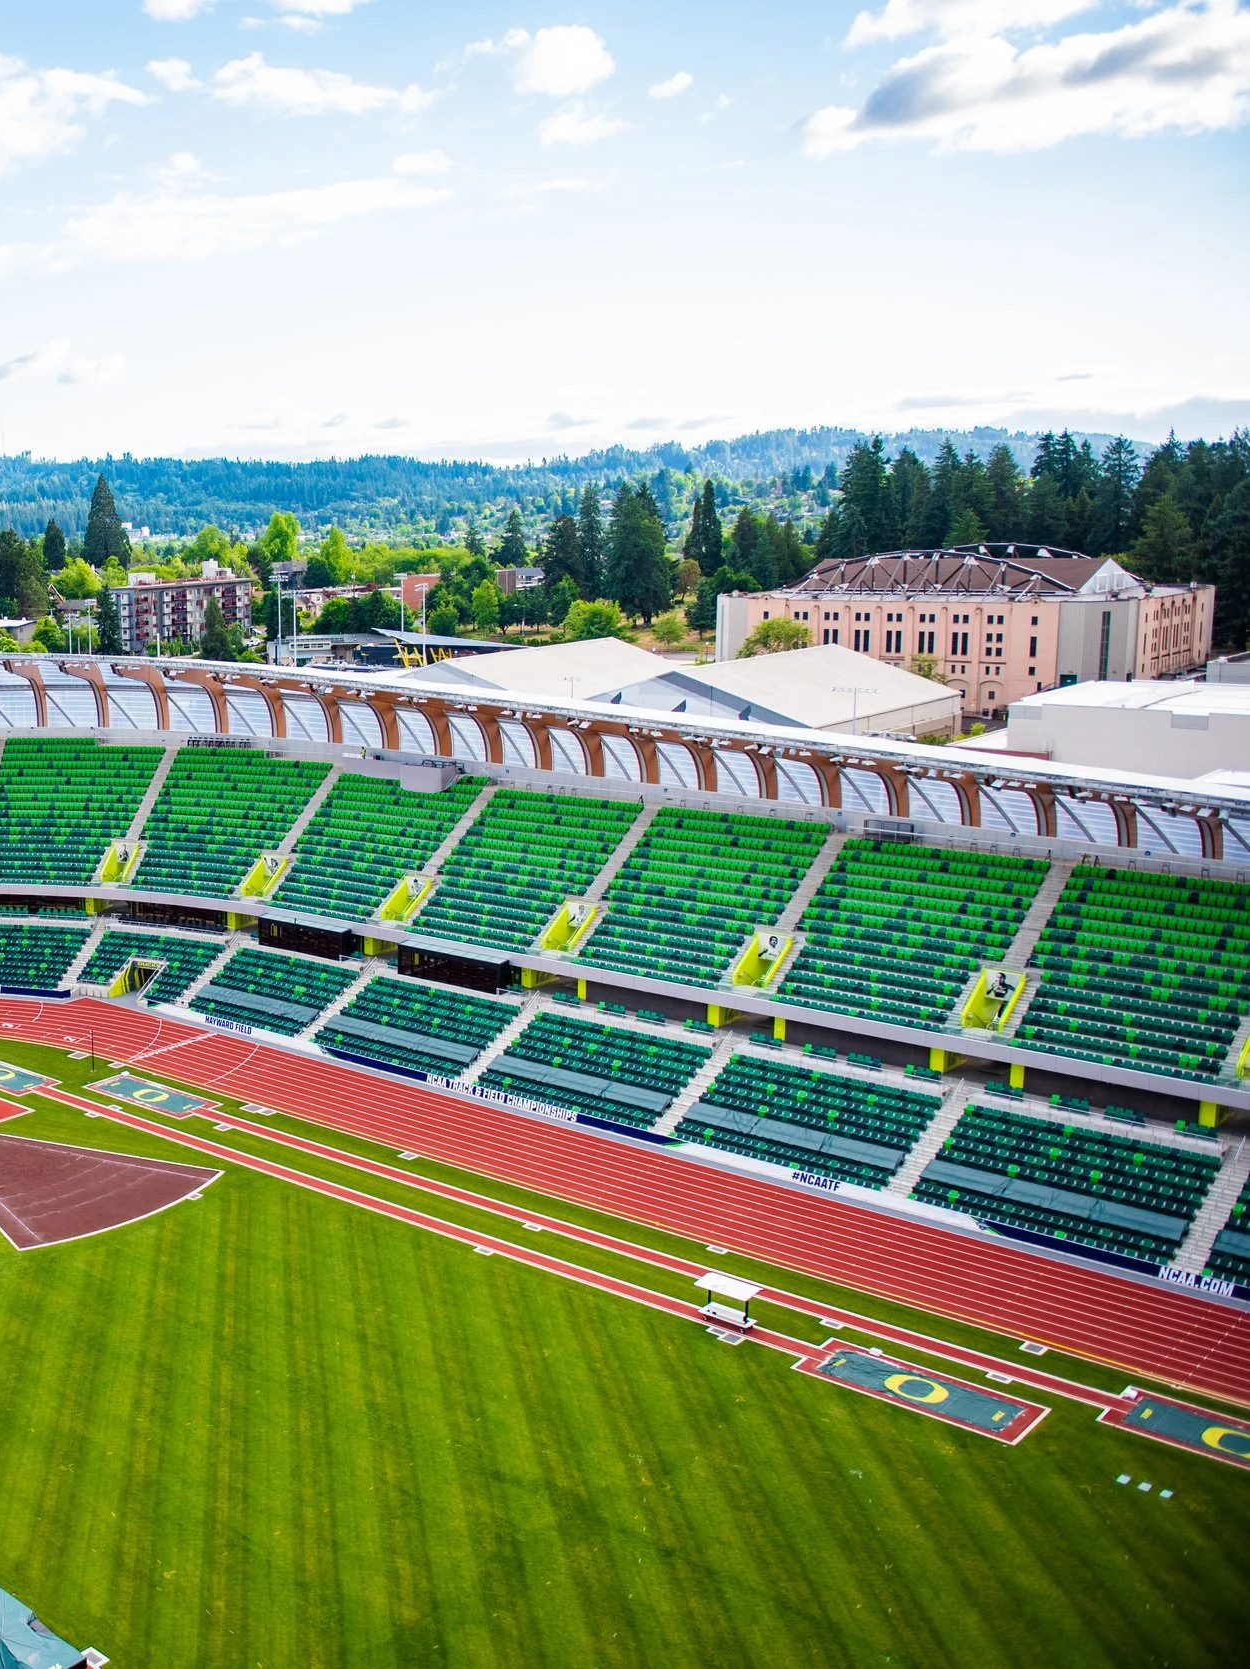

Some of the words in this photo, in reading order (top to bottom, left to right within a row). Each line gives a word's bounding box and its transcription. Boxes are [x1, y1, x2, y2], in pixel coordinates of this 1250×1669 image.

[205, 1015, 234, 1030] HAYWARD
[235, 1023, 252, 1034] FIELD
[427, 1073, 447, 1088] NCAA
[449, 1079, 474, 1096] TRACK
[483, 1088, 505, 1103] FIELD
[506, 1093, 578, 1122] CHAMPIONSHIPS
[792, 1171, 841, 1191] #NCAATF
[1158, 1265, 1235, 1297] NCAA.COM
